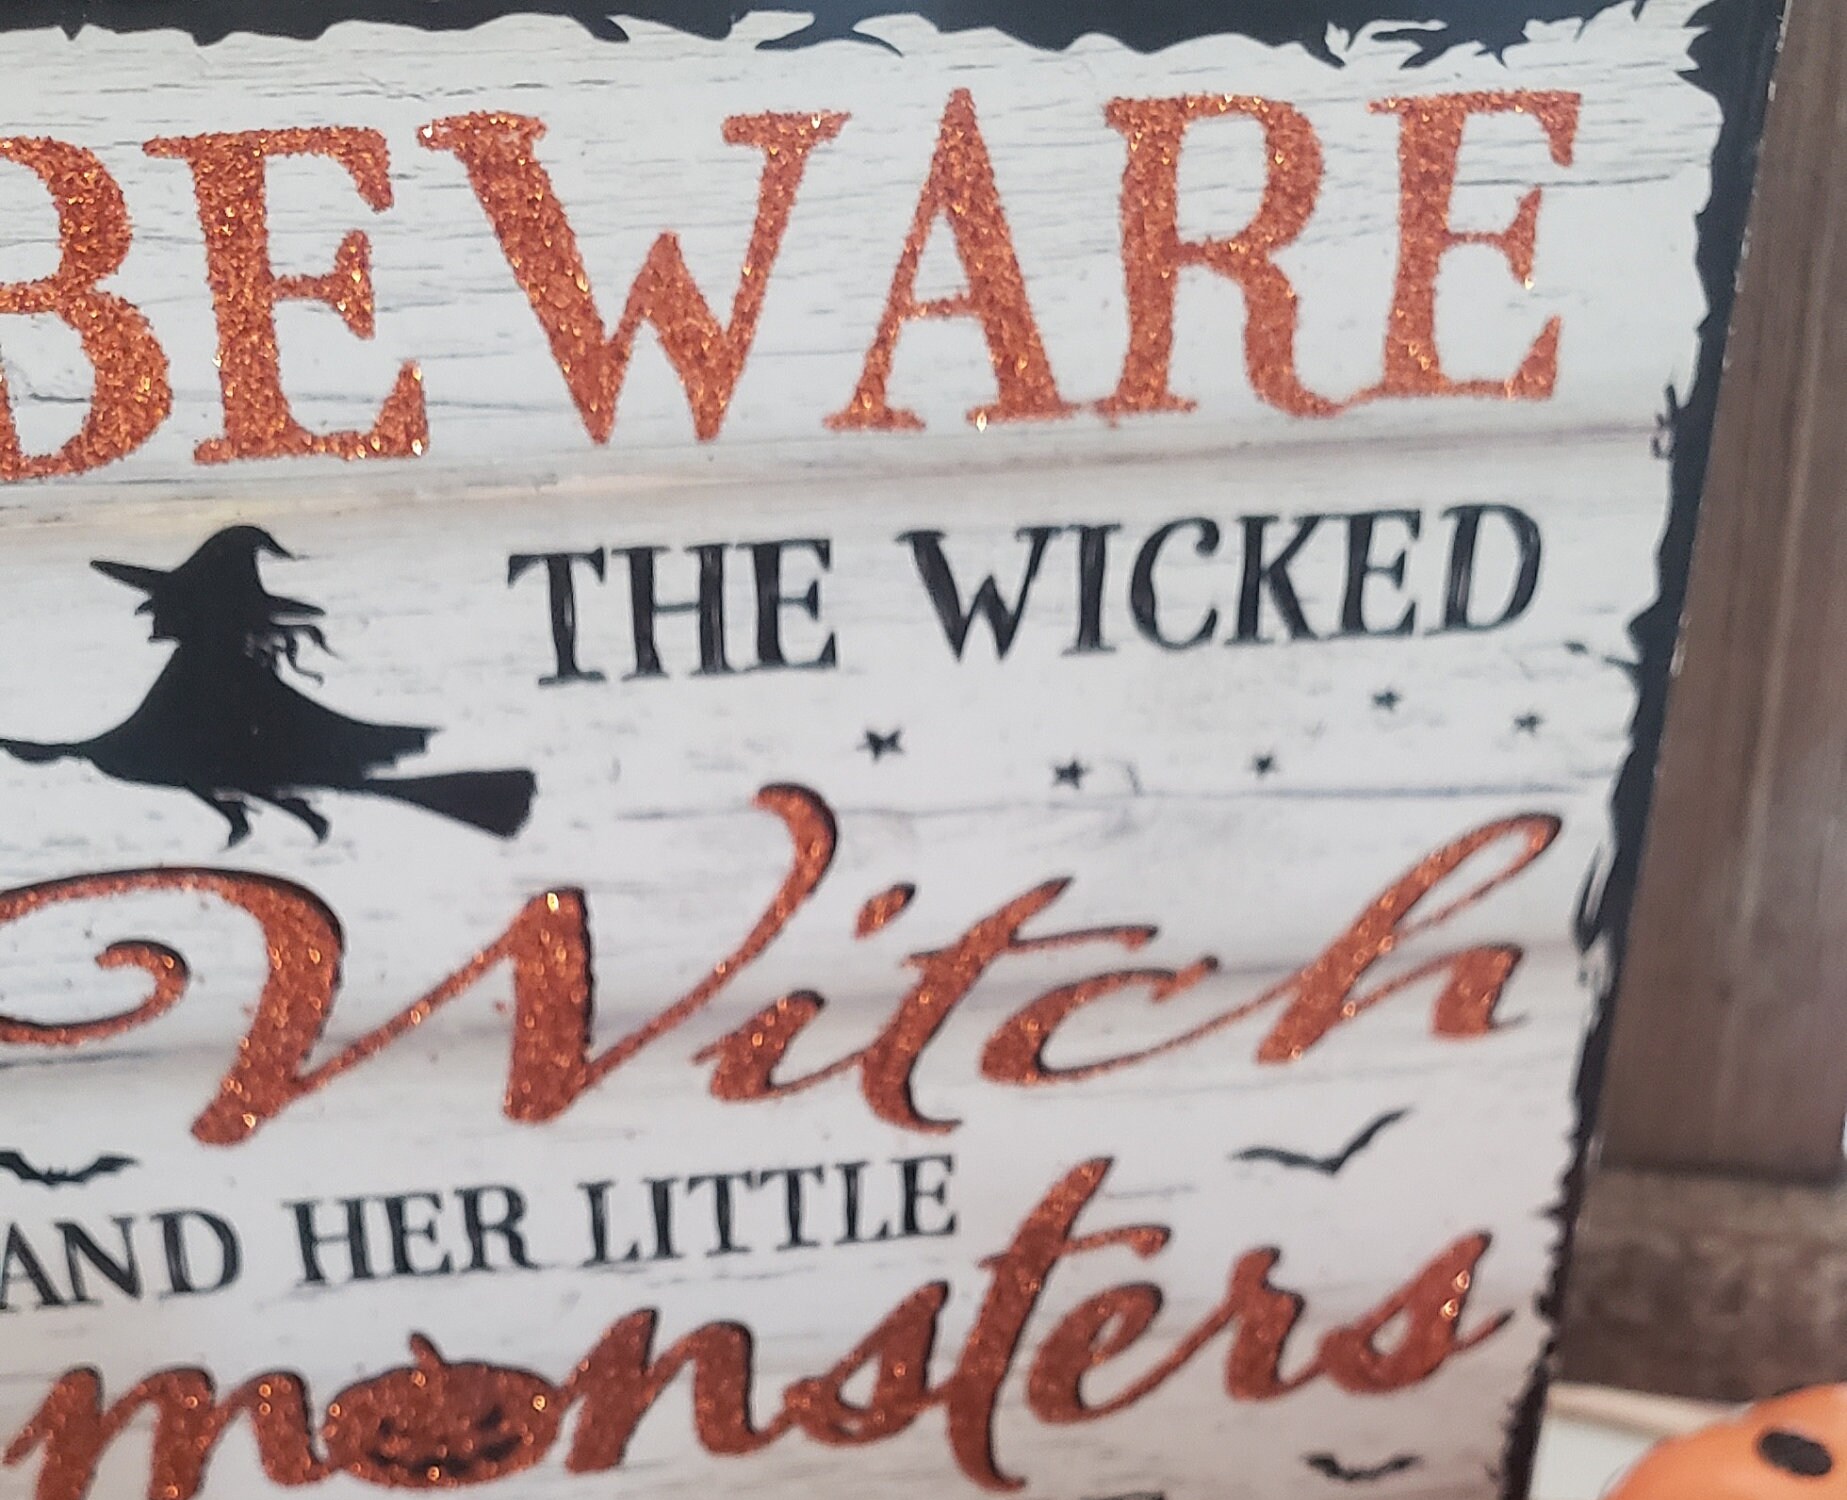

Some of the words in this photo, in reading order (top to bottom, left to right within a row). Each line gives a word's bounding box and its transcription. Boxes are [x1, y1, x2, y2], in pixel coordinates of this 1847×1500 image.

[507, 538, 841, 688] THE
[895, 503, 1543, 663] WICKED
[0, 780, 1562, 1147] Witch
[0, 1208, 244, 1313] AND
[282, 1182, 550, 1288] HER
[575, 1155, 958, 1265] LITTLE
